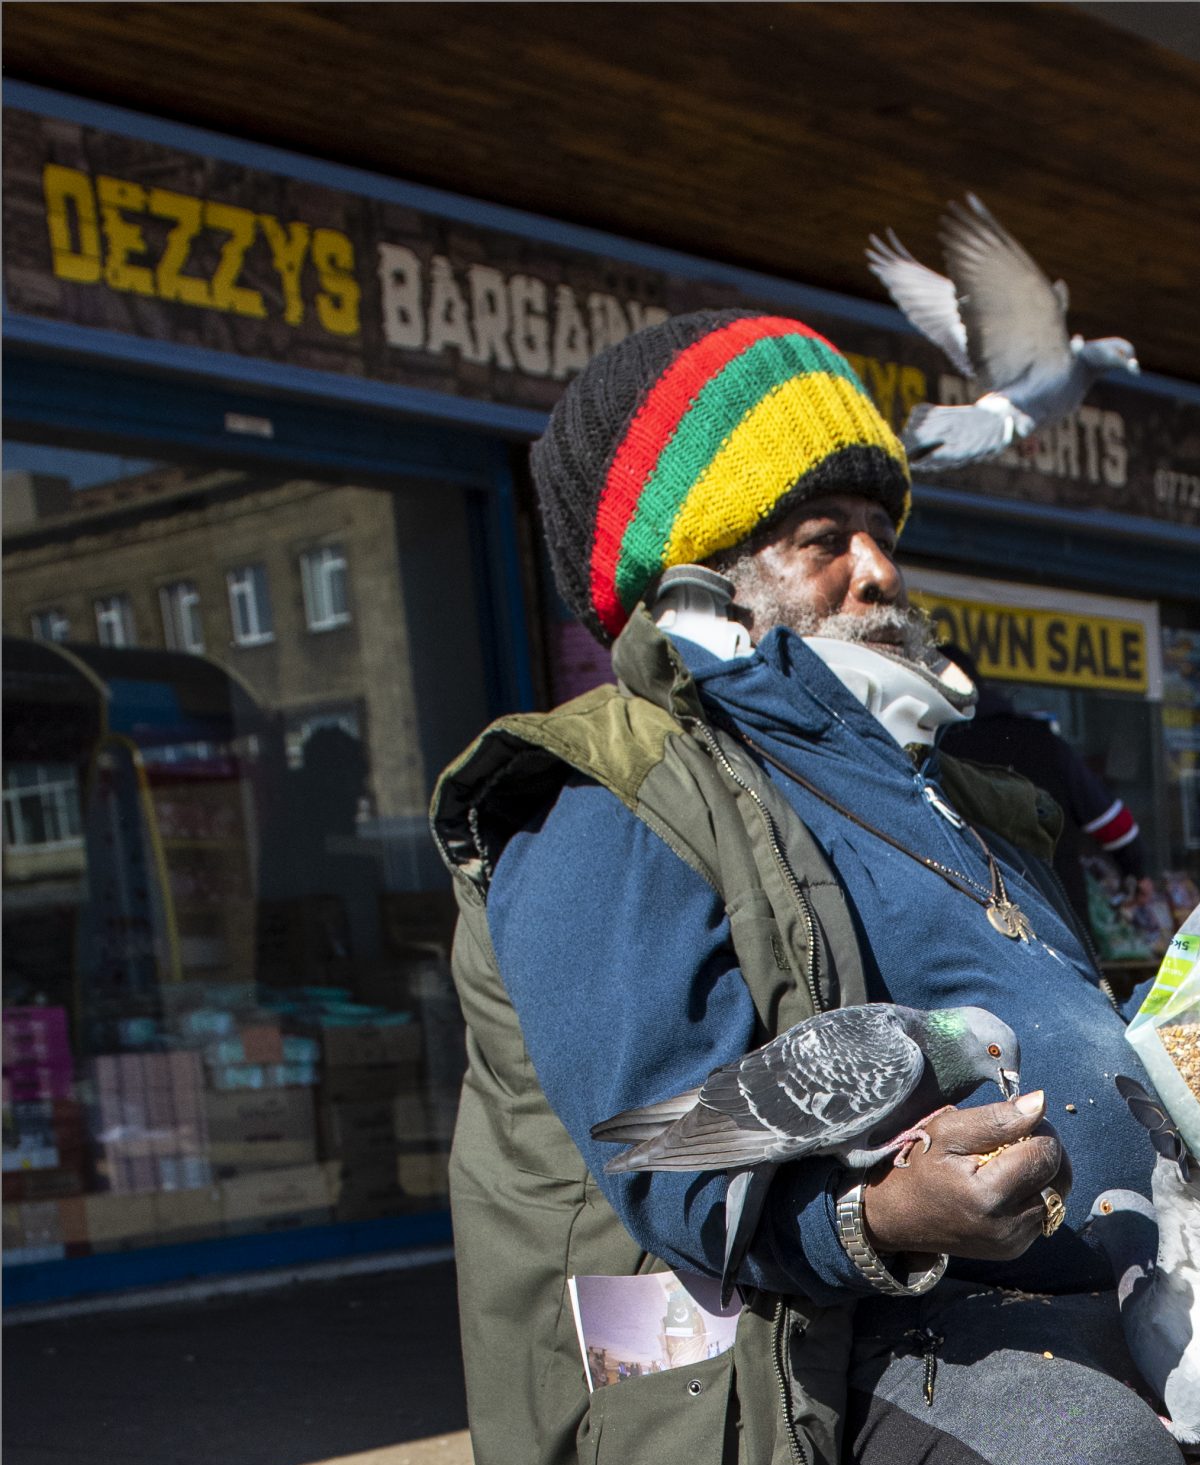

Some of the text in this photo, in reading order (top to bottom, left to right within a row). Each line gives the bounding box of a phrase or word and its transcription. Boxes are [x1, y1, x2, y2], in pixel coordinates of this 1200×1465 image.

[43, 163, 361, 336] DEZZYS
[930, 605, 1142, 680] OWN SALE
